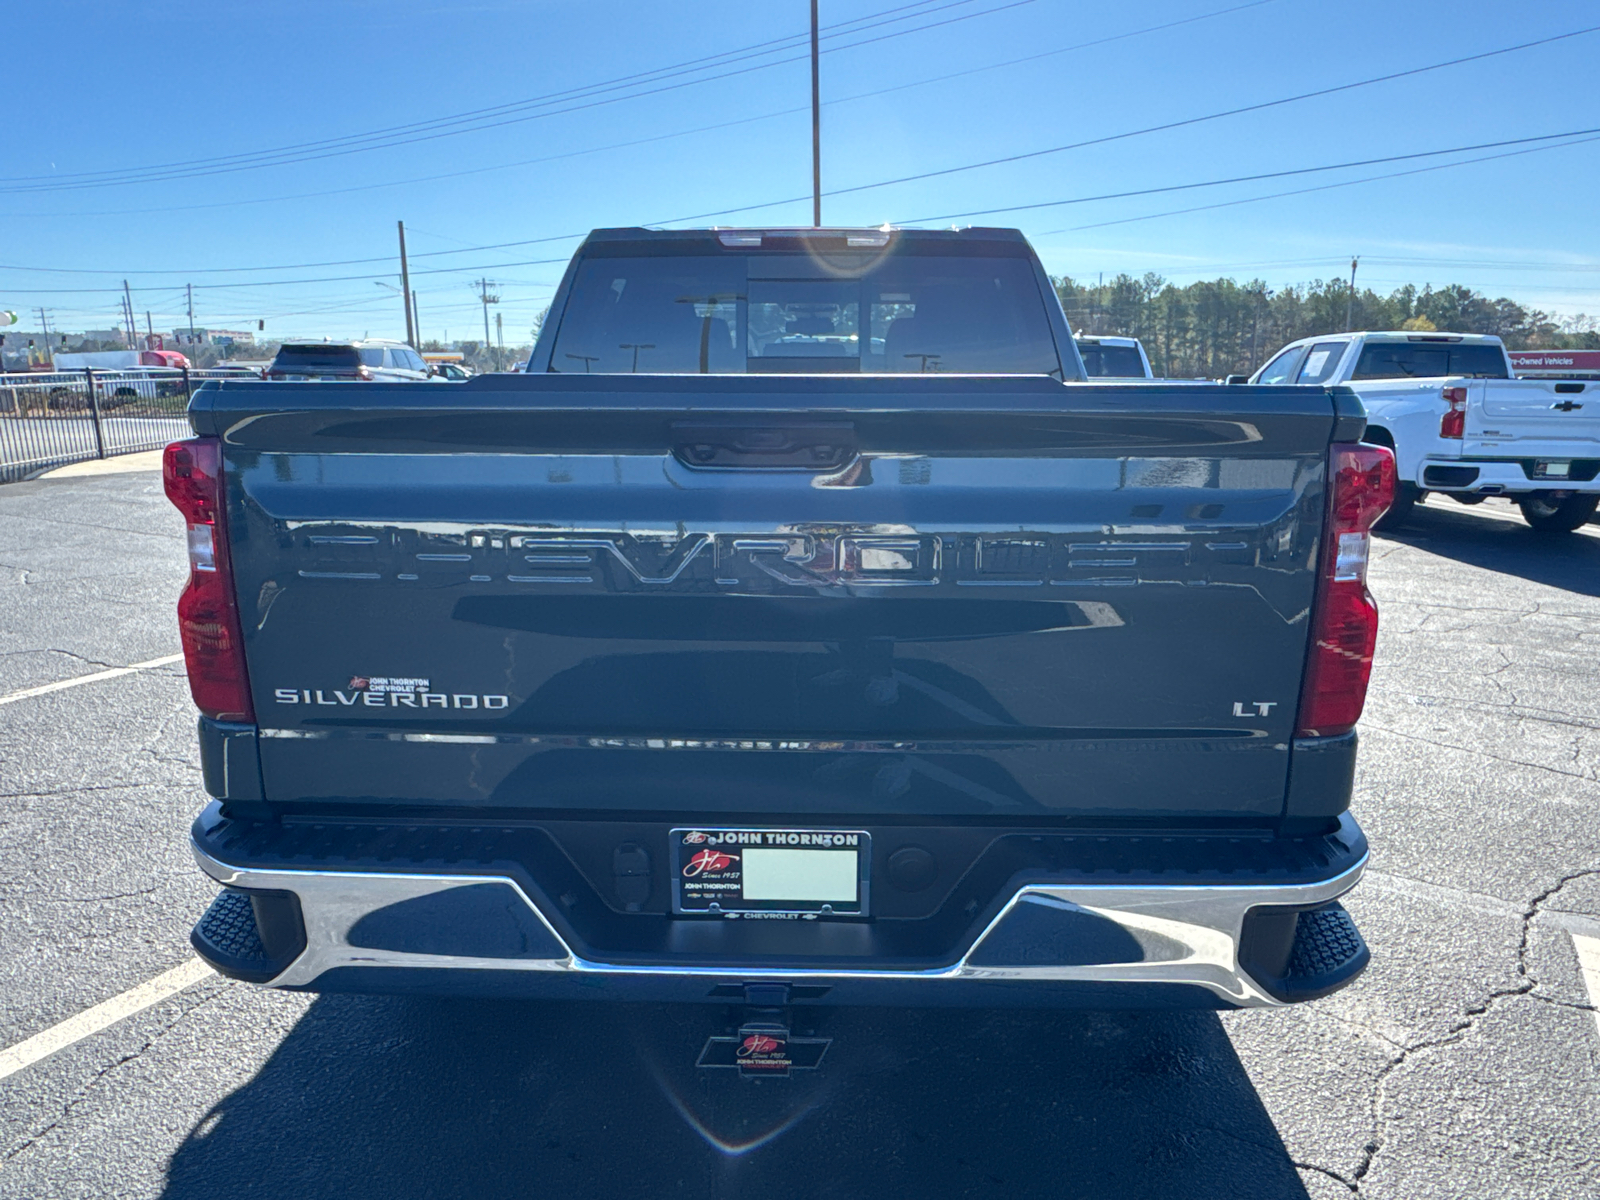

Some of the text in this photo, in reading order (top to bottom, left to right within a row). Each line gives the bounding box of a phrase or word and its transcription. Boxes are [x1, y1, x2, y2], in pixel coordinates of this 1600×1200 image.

[1511, 357, 1573, 366] re-Owned Vehicles
[369, 677, 430, 686] JOHN THORNTON
[369, 685, 415, 693] CHEVROLET
[274, 688, 509, 709] SILVERADO
[1232, 702, 1278, 717] LT
[716, 832, 763, 844] JOHN
[766, 833, 859, 847] THORNTON
[722, 871, 740, 879] 1957
[685, 882, 741, 890] JOHN THORNTON
[743, 912, 800, 920] CHEVROLET
